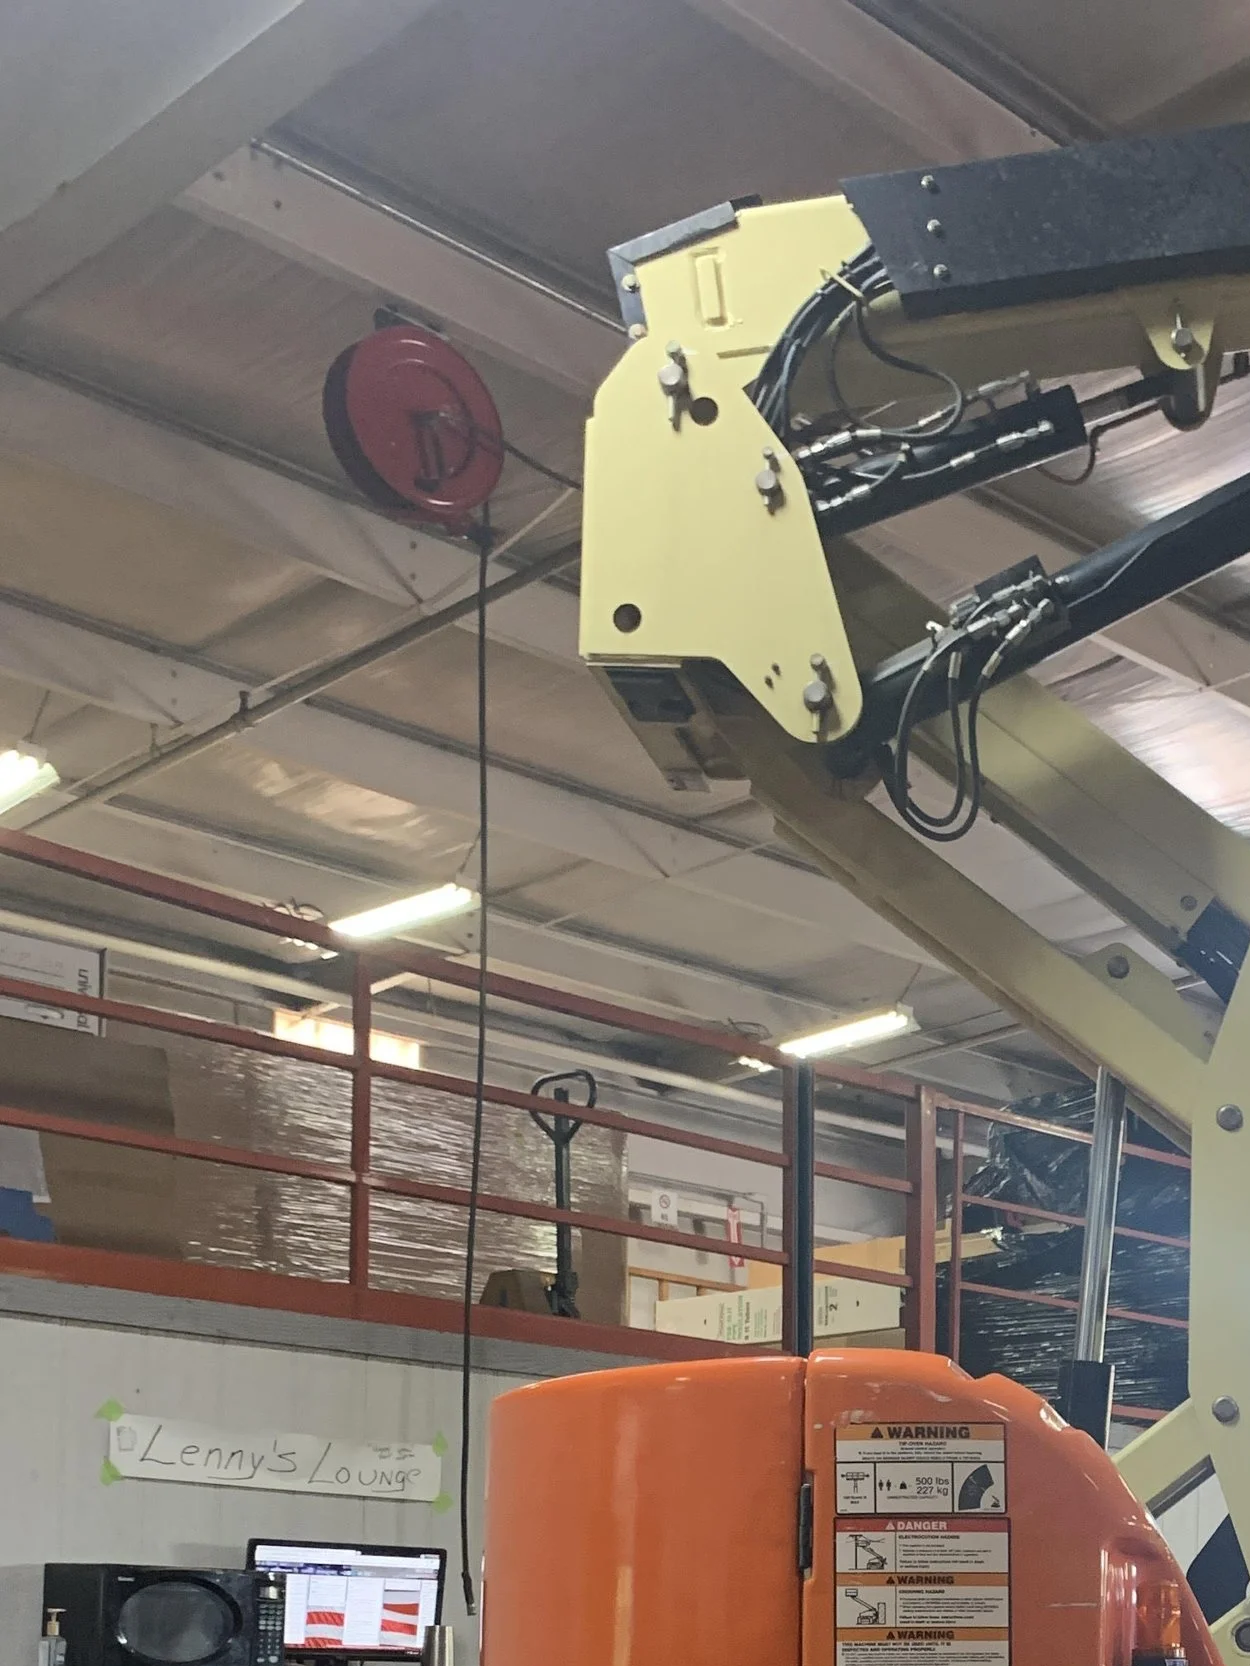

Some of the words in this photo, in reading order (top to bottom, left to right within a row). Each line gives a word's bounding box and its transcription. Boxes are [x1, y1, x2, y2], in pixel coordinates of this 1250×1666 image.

[886, 1426, 970, 1439] WARNING
[139, 1424, 297, 1480] Lenny's
[915, 1476, 933, 1486] 500
[935, 1476, 950, 1486] lbs
[916, 1486, 934, 1495] 227
[936, 1486, 949, 1496] kg
[897, 1521, 948, 1531] DANGER
[897, 1575, 955, 1585] WARNING
[897, 1630, 955, 1640] WARNING
